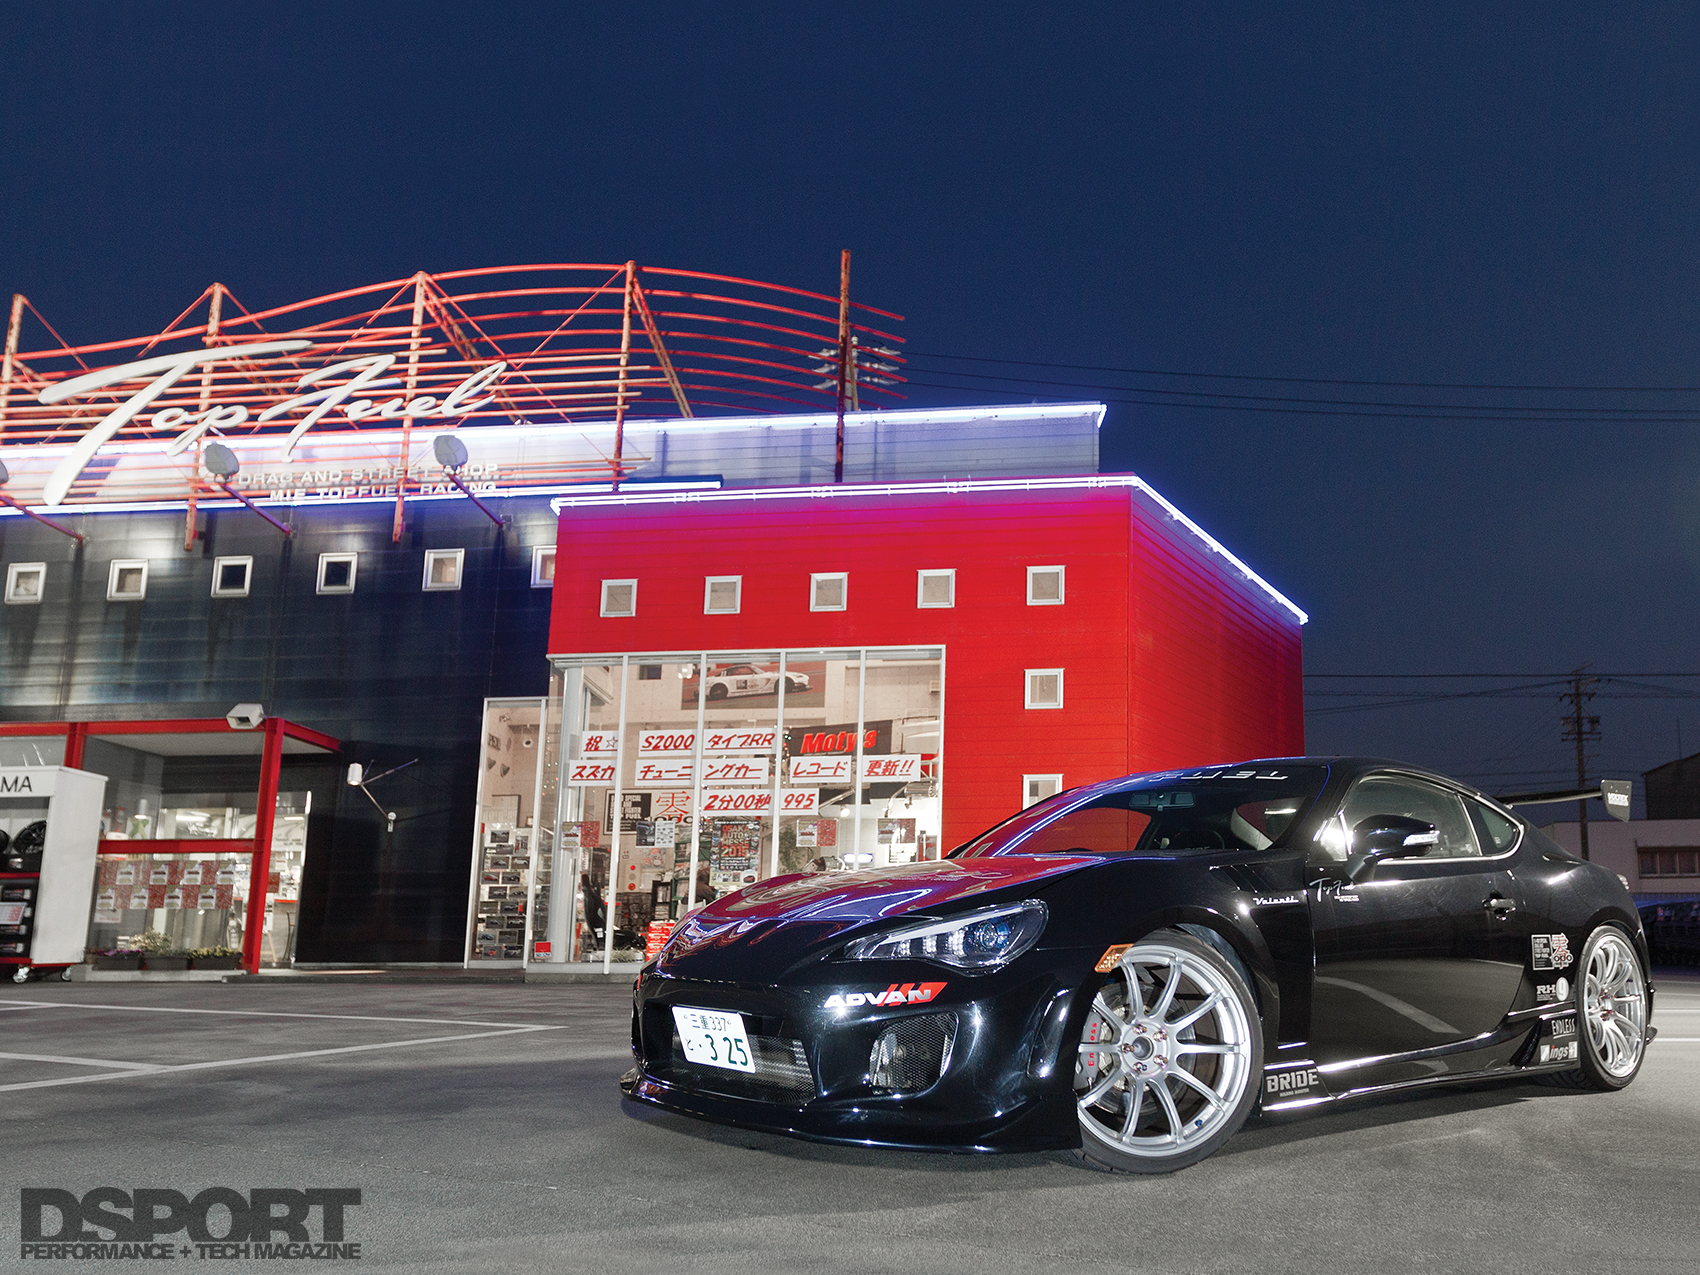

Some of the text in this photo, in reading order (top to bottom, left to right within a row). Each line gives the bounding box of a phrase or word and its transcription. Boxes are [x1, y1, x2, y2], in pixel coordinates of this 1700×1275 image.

[237, 471, 294, 487] DRAG
[300, 468, 343, 484] AND
[350, 465, 430, 482] STREET
[315, 483, 411, 500] TOPFUEL
[419, 480, 498, 496] RACNG
[642, 734, 695, 750] S2000
[823, 989, 931, 1008] ADVAN
[1551, 1018, 1576, 1035] ENDLESS
[1266, 1069, 1319, 1093] BRIDE
